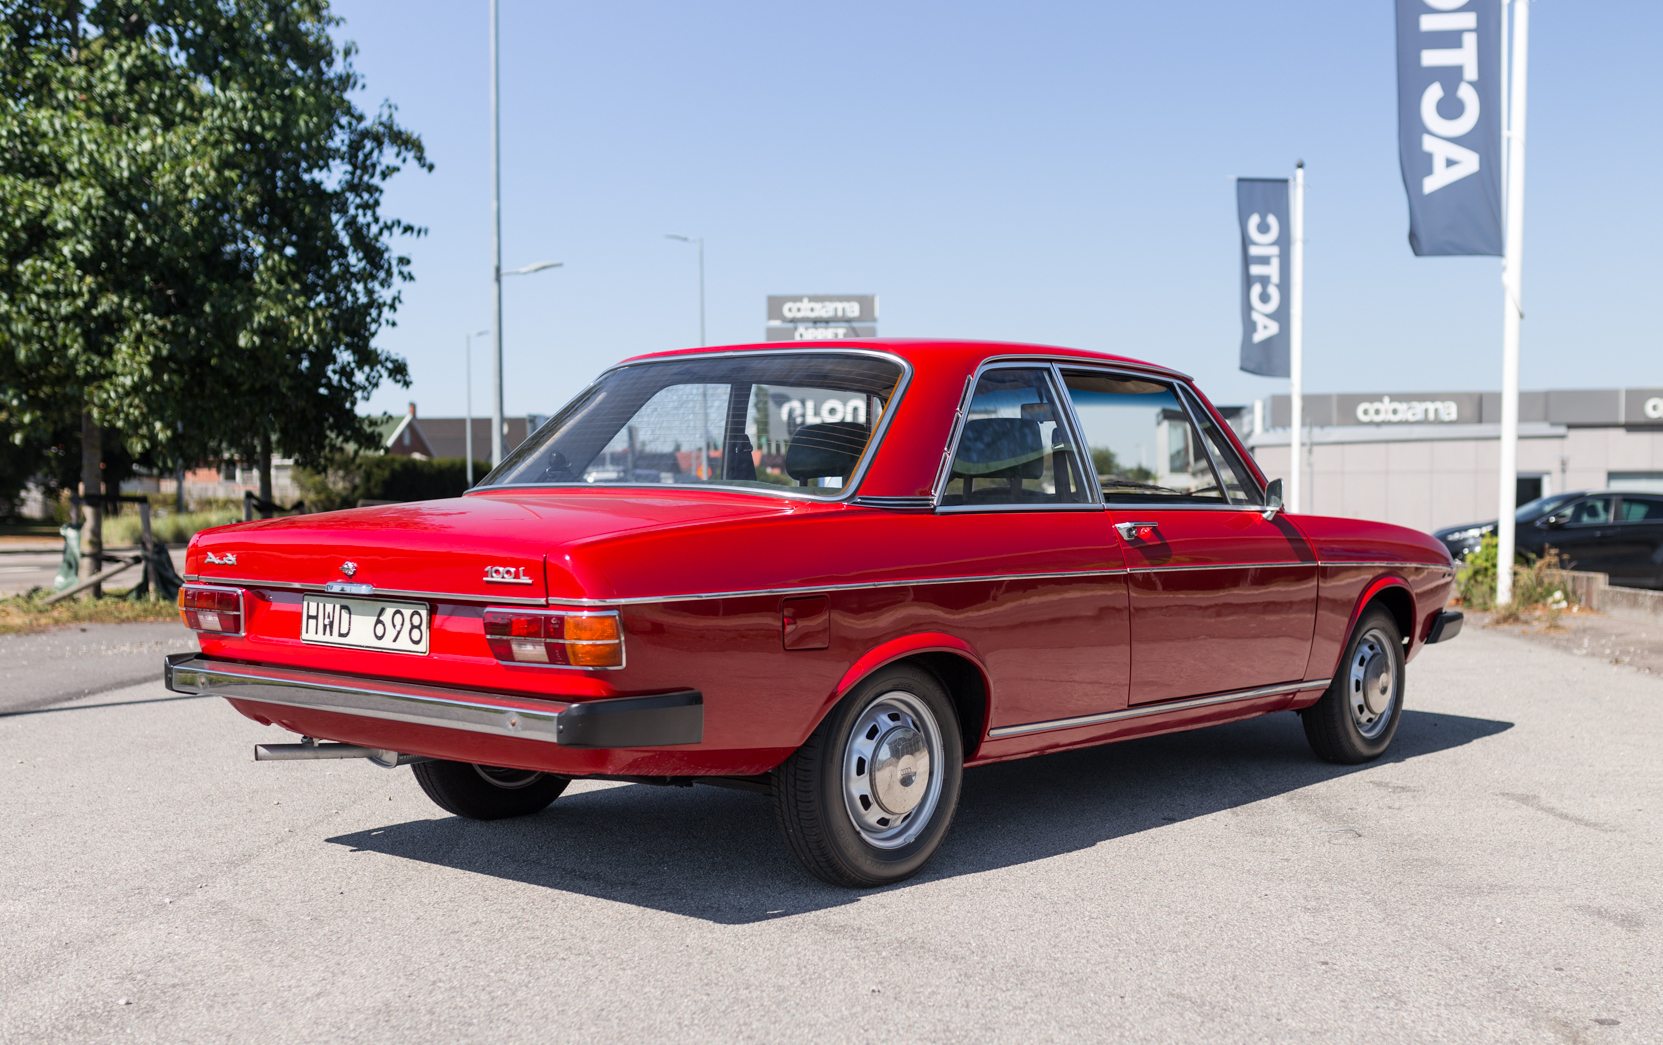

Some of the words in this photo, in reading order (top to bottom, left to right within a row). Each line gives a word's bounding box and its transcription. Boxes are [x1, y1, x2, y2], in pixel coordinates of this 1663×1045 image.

[782, 296, 860, 319] colorama
[1356, 395, 1458, 422] colorama
[204, 551, 237, 566] Audi
[484, 565, 516, 579] 100
[305, 601, 352, 638] HWD
[373, 607, 423, 645] 698
[909, 666, 950, 708] TOYO
